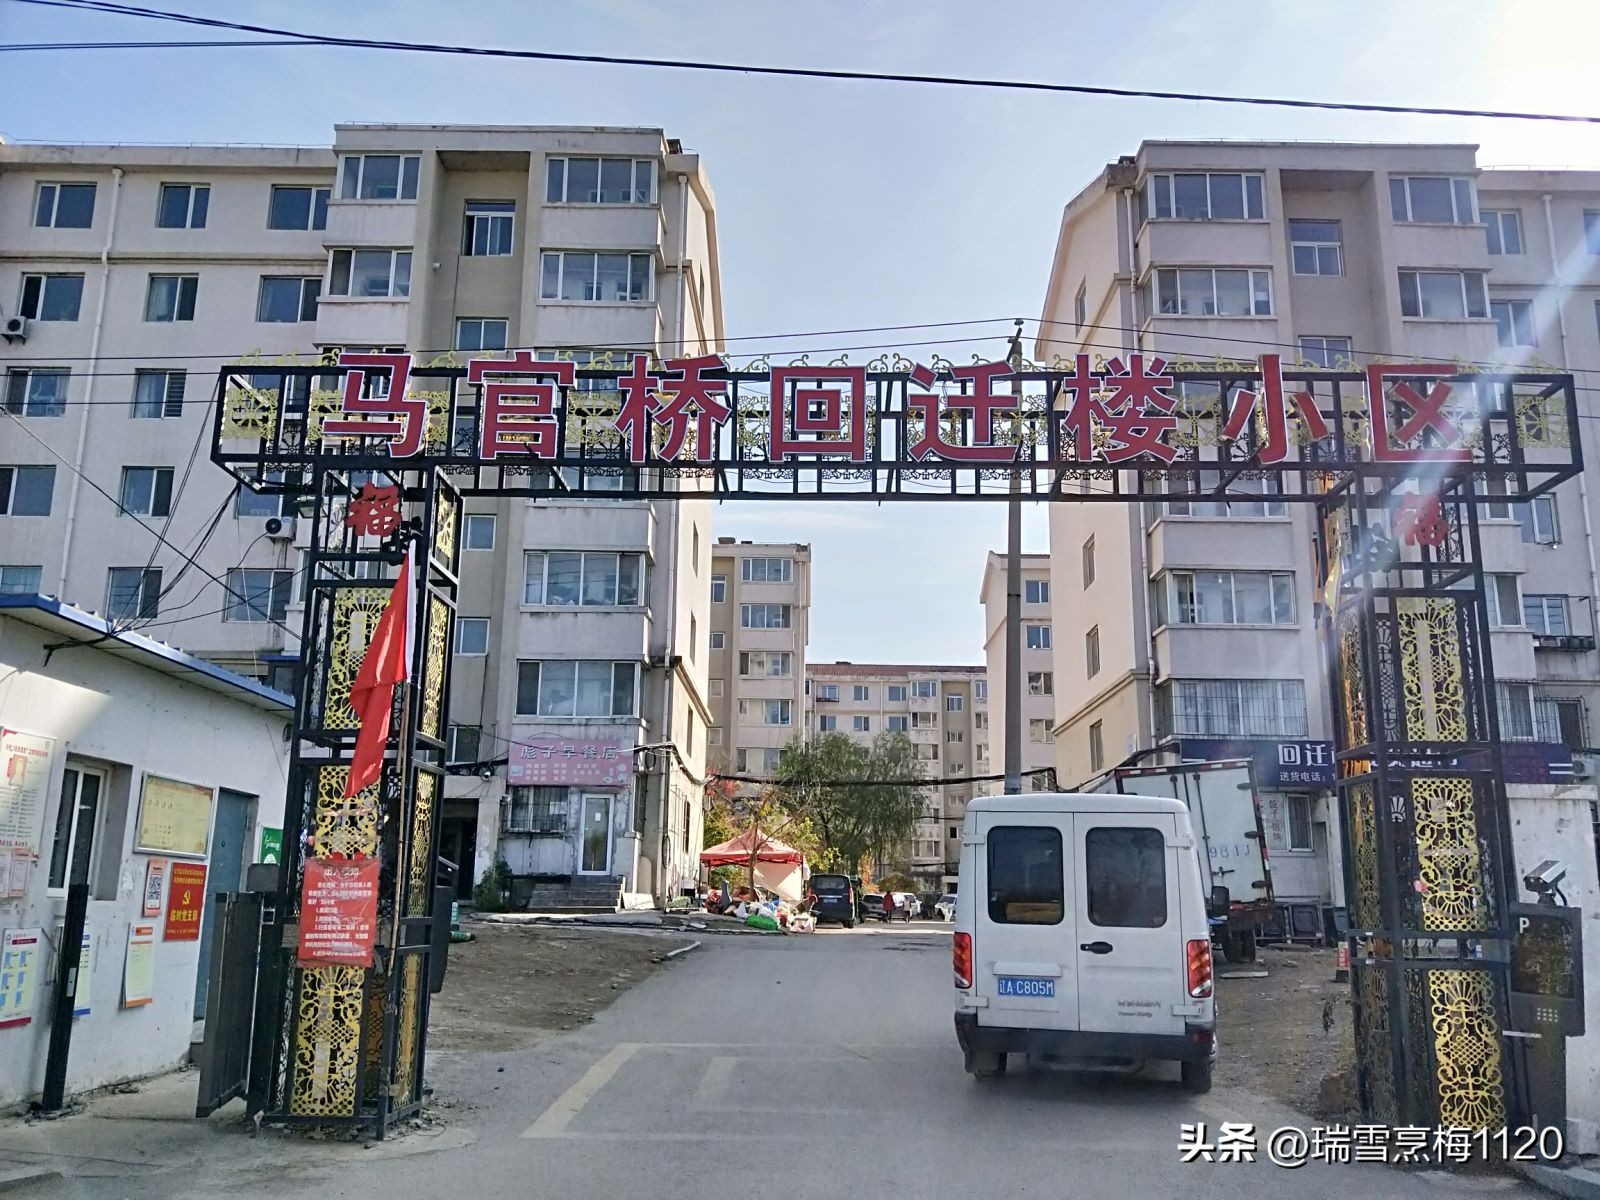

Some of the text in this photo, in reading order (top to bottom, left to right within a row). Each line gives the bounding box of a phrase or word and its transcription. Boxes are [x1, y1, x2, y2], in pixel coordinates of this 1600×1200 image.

[321, 351, 1473, 466] 马官桥回迁楼小区
[346, 482, 402, 538] 福
[520, 745, 618, 759] 彪子早餐店
[1519, 917, 1530, 933] P
